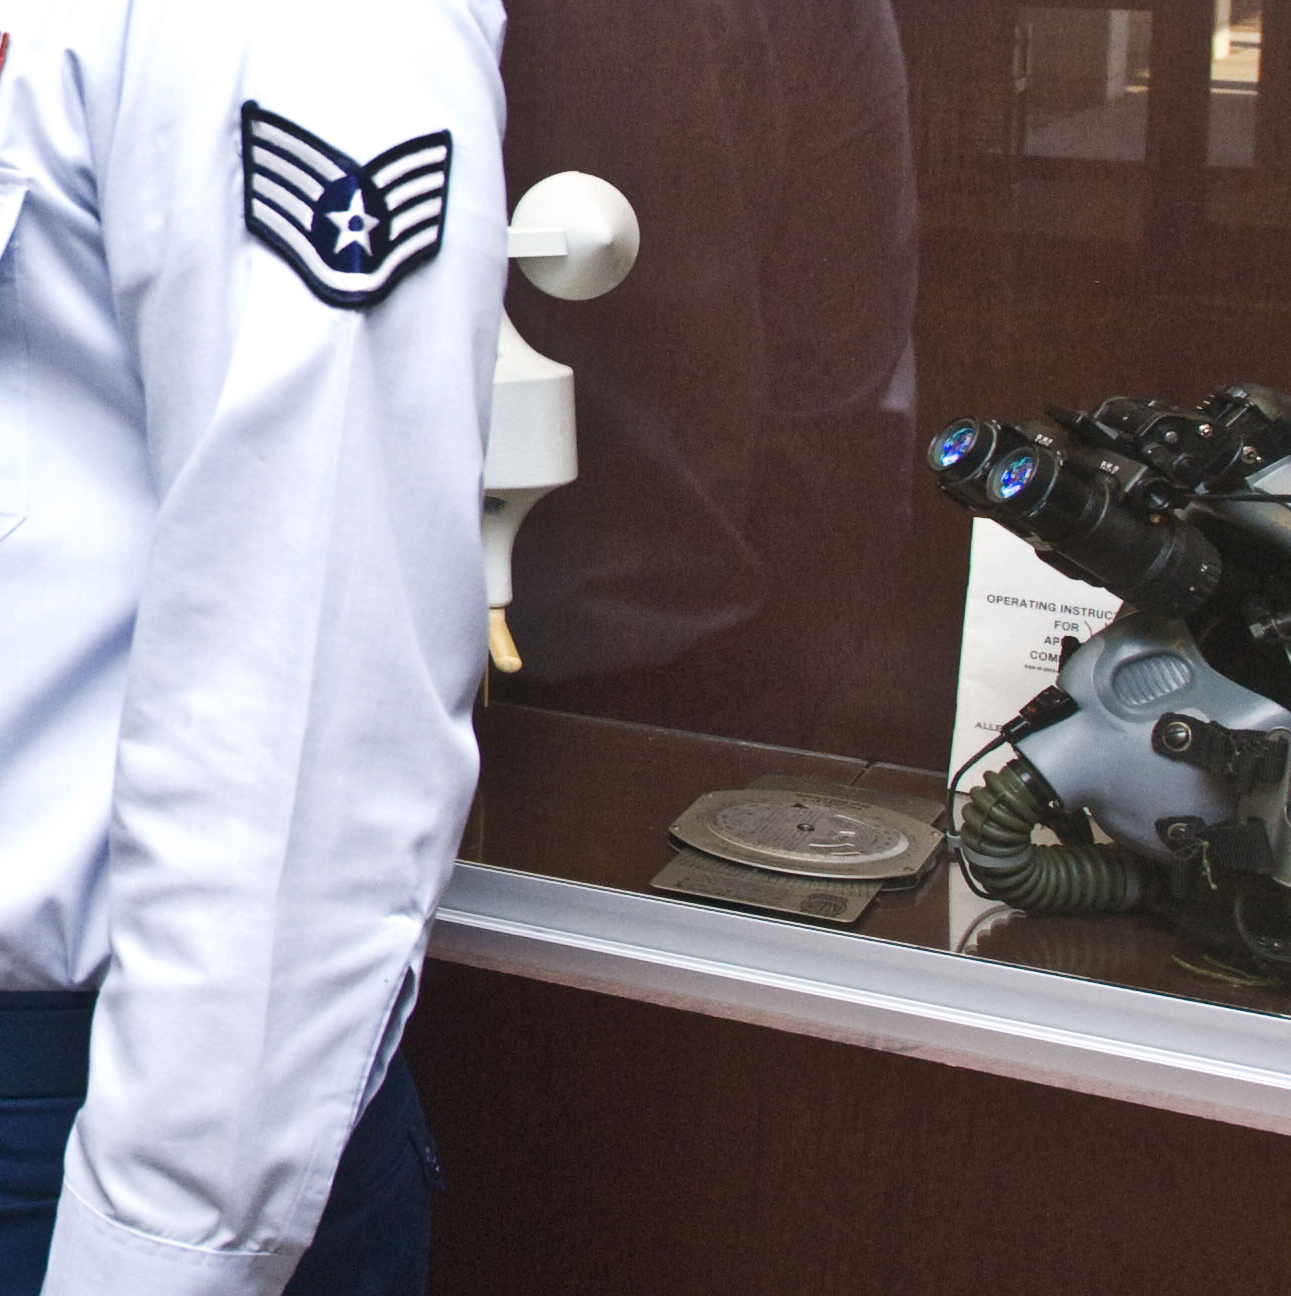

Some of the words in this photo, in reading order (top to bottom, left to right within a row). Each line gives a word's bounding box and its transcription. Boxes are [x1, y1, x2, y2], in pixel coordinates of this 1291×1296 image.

[986, 594, 1057, 612] OPERATING
[1060, 604, 1117, 620] INSTRUC
[1054, 620, 1080, 632] FOR
